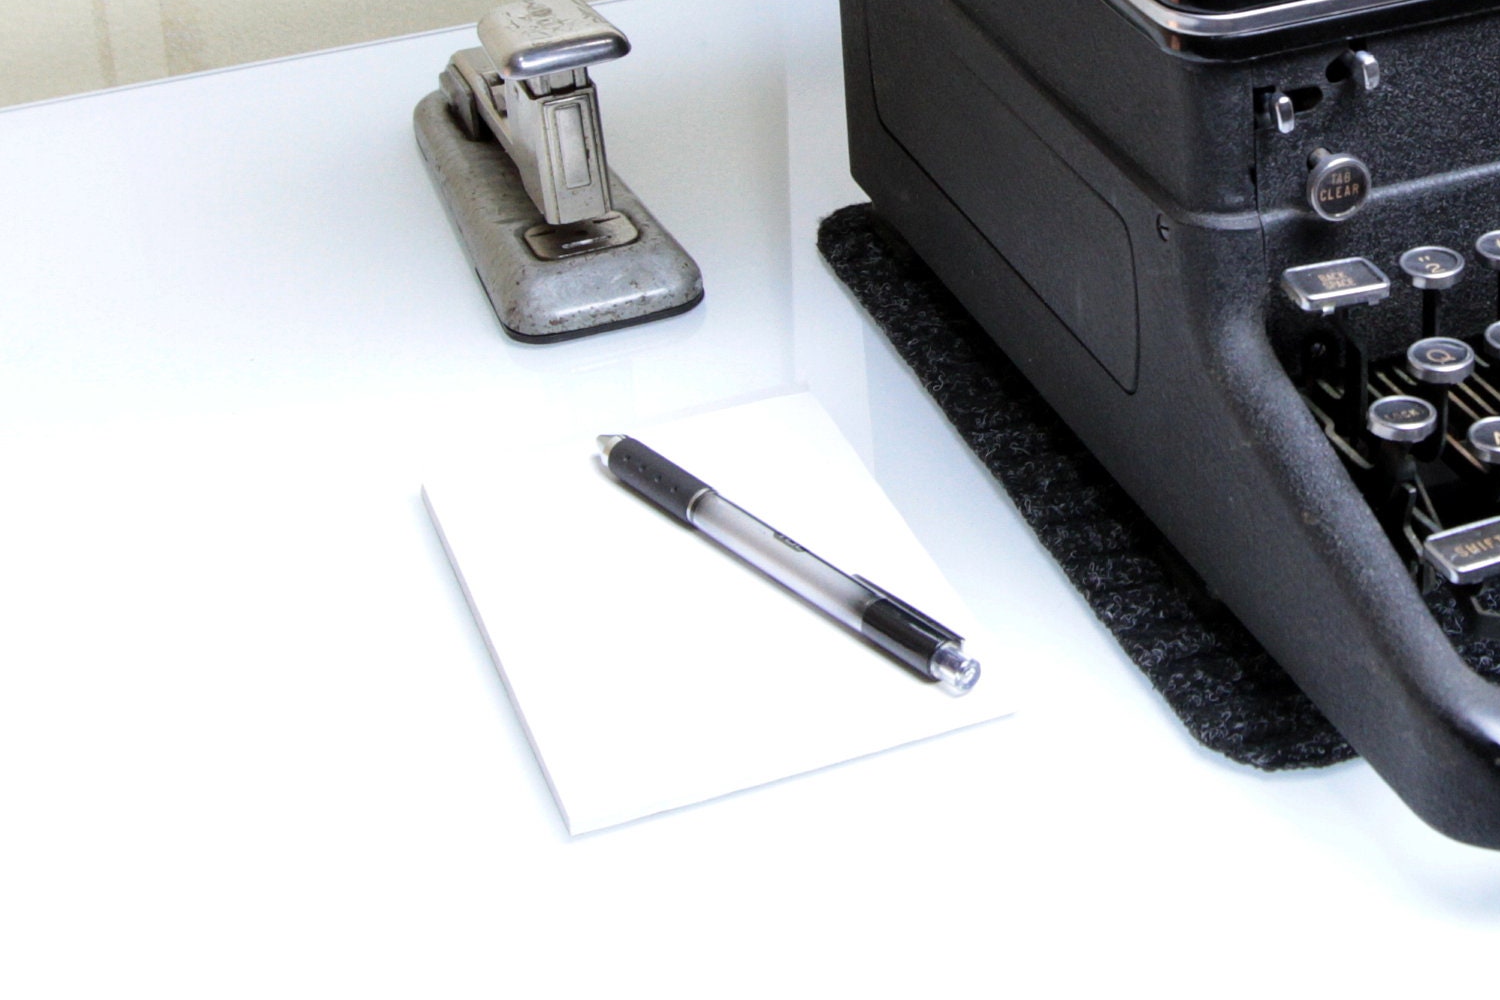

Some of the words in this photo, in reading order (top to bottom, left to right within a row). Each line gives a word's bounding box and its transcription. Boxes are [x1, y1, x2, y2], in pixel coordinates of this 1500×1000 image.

[1331, 171, 1352, 185] TAB
[1319, 183, 1360, 202] CLEAR
[1426, 349, 1456, 364] Q
